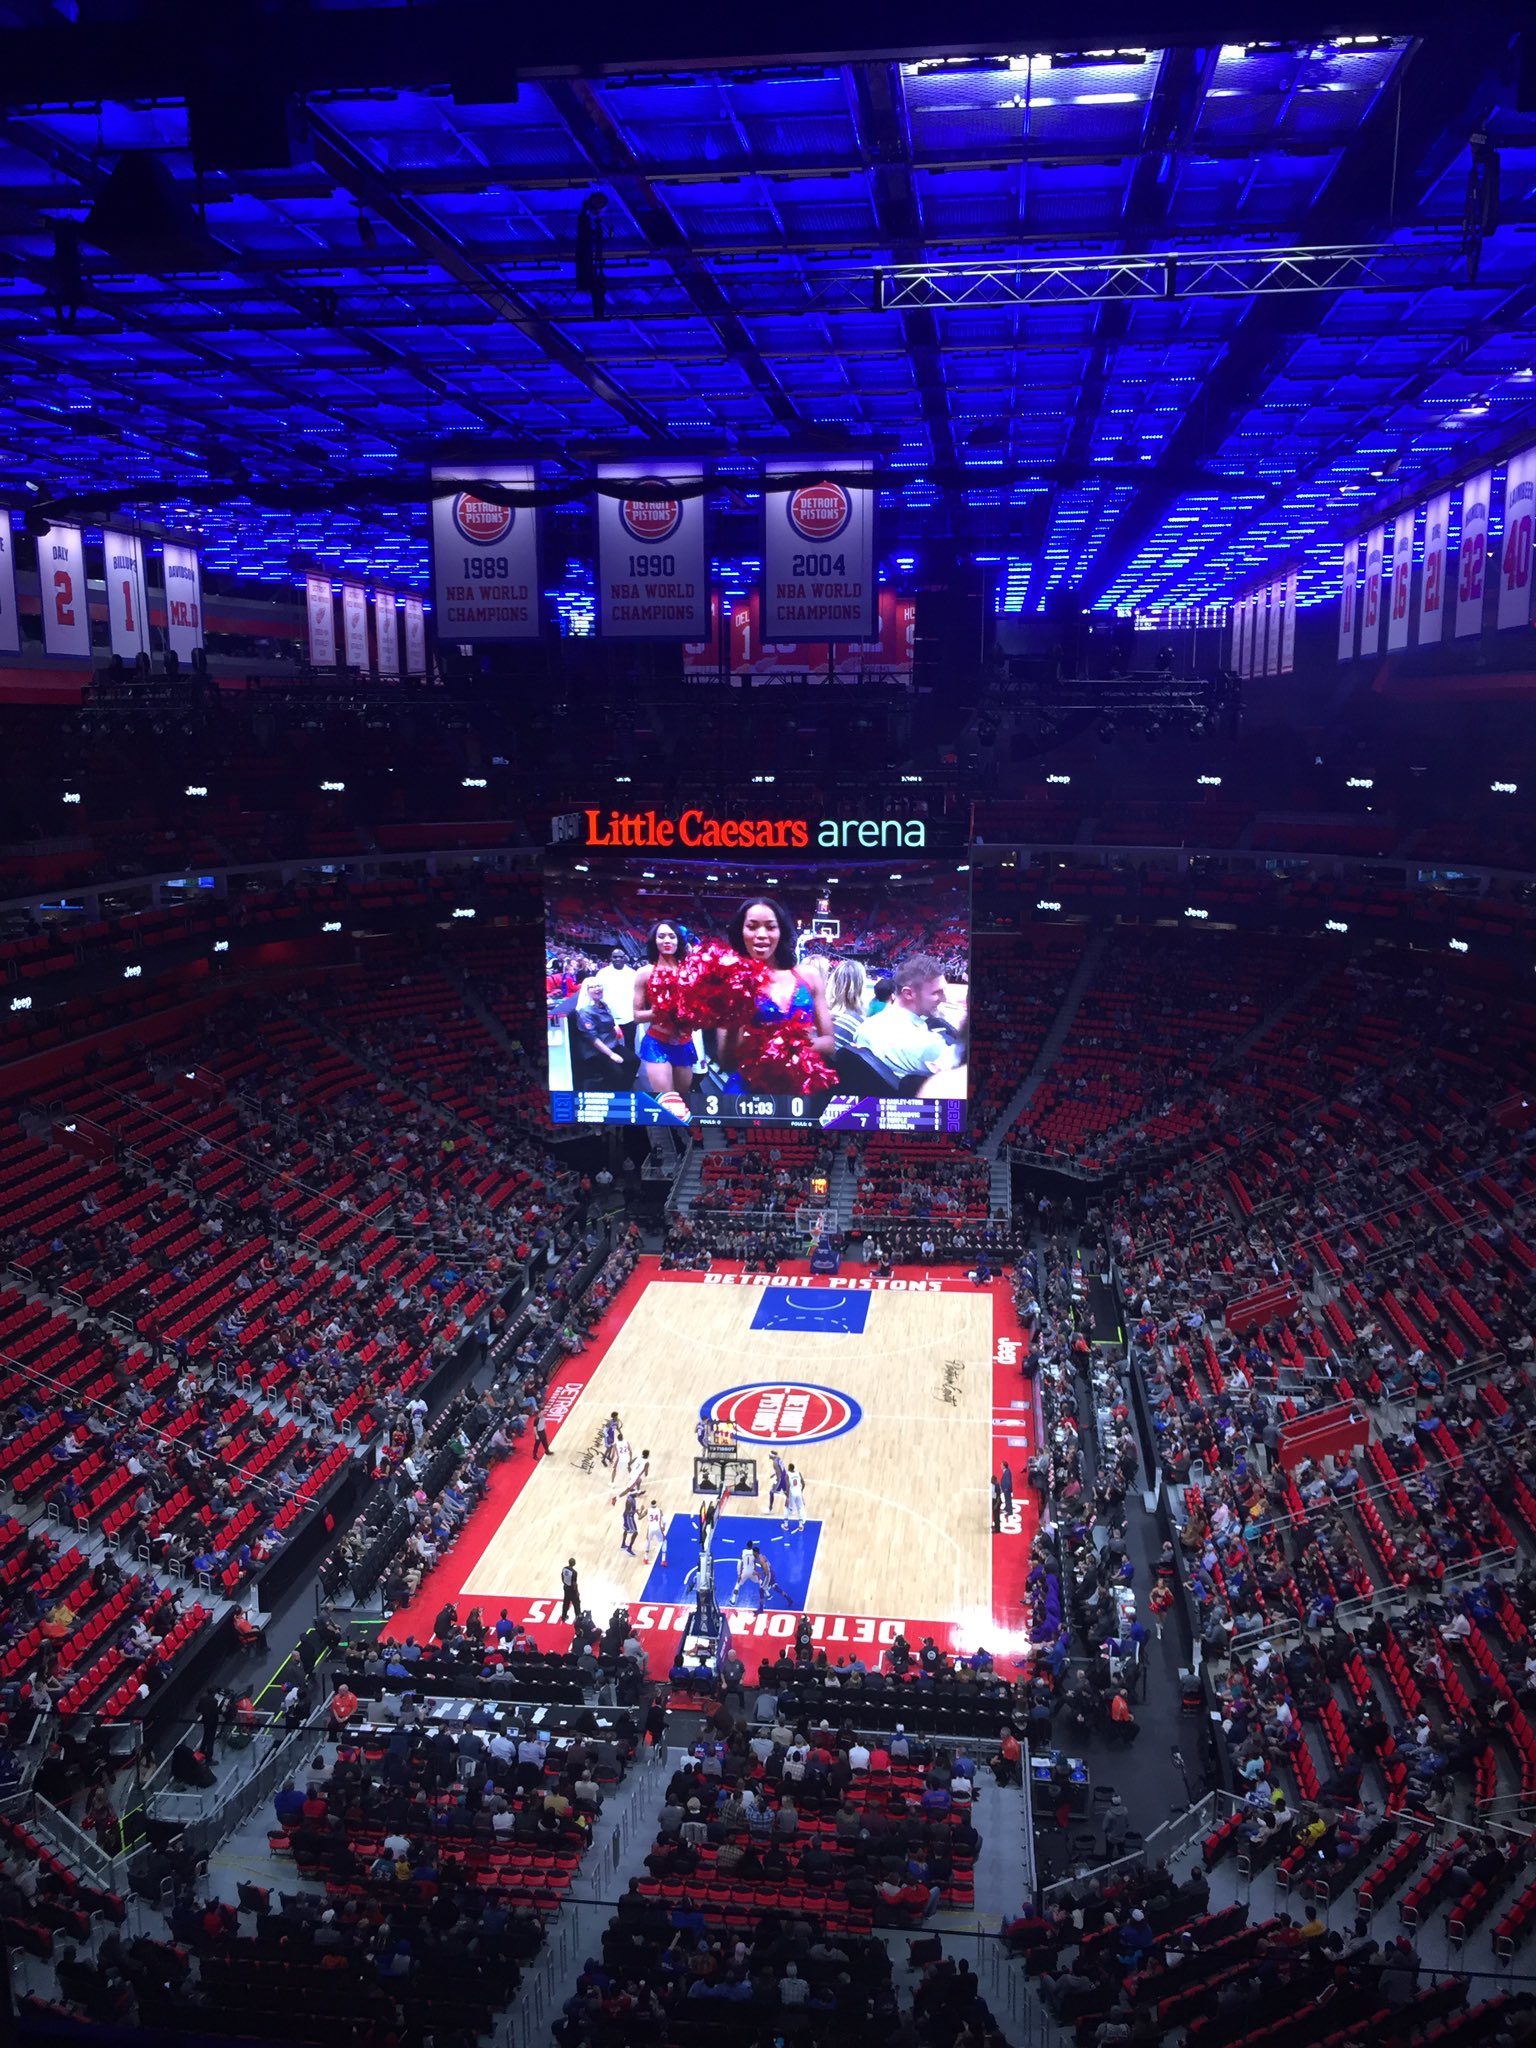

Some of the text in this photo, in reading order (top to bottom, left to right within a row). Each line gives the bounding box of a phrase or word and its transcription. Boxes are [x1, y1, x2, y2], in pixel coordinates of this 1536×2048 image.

[465, 502, 502, 513] DETROIT
[800, 498, 839, 508] DETROIT
[465, 512, 503, 524] PISTONS
[632, 509, 671, 521] PISTONS
[800, 508, 839, 520] PISTONS
[52, 546, 69, 562] DALY
[1503, 515, 1532, 591] 40
[113, 556, 138, 573] BILLUPS
[463, 557, 508, 579] 1989
[629, 555, 675, 577] 1990
[792, 554, 846, 577] 2004
[1459, 533, 1484, 602] 32
[168, 565, 195, 582] DAVIDSON
[1424, 550, 1442, 613] 21
[53, 570, 75, 626] 2
[446, 585, 528, 600] NBA WORLD
[611, 583, 695, 599] NBA WORLD
[776, 583, 862, 599] NBA WORLD
[1393, 562, 1409, 620] 16
[122, 580, 134, 632] 1
[1365, 573, 1379, 628] 15
[447, 607, 528, 622] CHAMPIONS
[612, 605, 694, 621] CHAMPIONS
[777, 605, 861, 621] CHAMPIONS
[320, 781, 345, 791] Jeep
[461, 777, 487, 788] Jeep
[1046, 774, 1070, 784] Jeep
[1197, 775, 1221, 786] Jeep
[1346, 777, 1373, 789] Jeep
[185, 785, 208, 797] Jeep
[1490, 781, 1517, 794] Jeep
[63, 793, 81, 803] Jeep
[585, 810, 675, 847] Little
[678, 810, 809, 848] Caesars
[817, 820, 926, 848] arena
[453, 908, 476, 918] Jeep
[1036, 900, 1061, 911] Jeep
[1184, 907, 1208, 919] Jeep
[322, 921, 342, 932] Jeep
[1325, 919, 1348, 932] Jeep
[214, 940, 229, 952] Jeep
[1449, 938, 1469, 952] Jeep
[124, 965, 142, 978] Jeep
[10, 996, 32, 1011] Jeep
[706, 1095, 719, 1115] 3
[739, 1101, 774, 1115] 11:03
[791, 1097, 804, 1117] 0
[652, 1113, 660, 1123] 7
[860, 1117, 867, 1127] 7
[703, 1272, 943, 1292] DETROIT PISTONS
[992, 1337, 1022, 1365] Jeep
[545, 1382, 583, 1424] DETROIT
[751, 1392, 786, 1432] PISTONS
[778, 1394, 811, 1433] DETROIT
[649, 1514, 659, 1522] 34
[522, 1600, 693, 1632] PISNS
